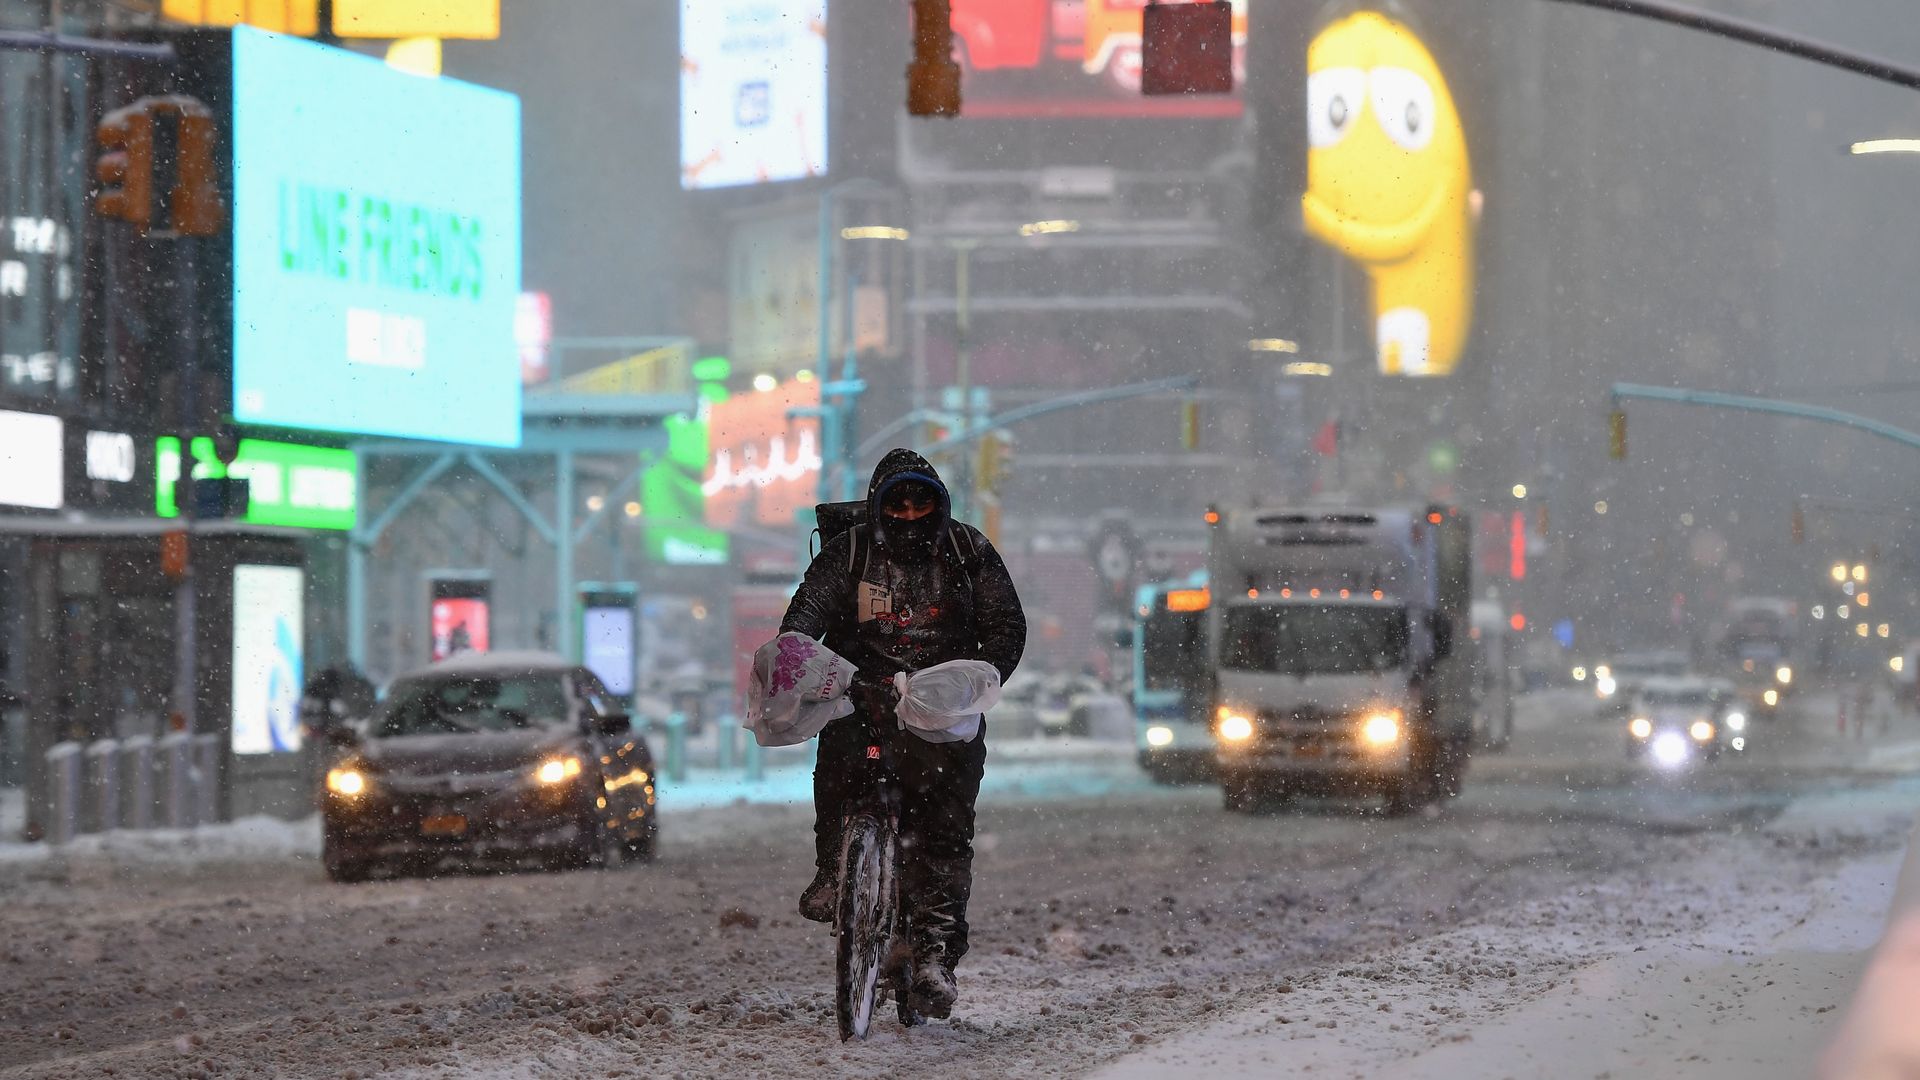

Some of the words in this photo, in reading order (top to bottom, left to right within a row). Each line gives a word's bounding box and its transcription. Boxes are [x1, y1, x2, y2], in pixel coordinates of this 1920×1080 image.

[279, 178, 347, 278] LINE
[360, 195, 482, 301] FRIENDS
[820, 671, 838, 700] You!
